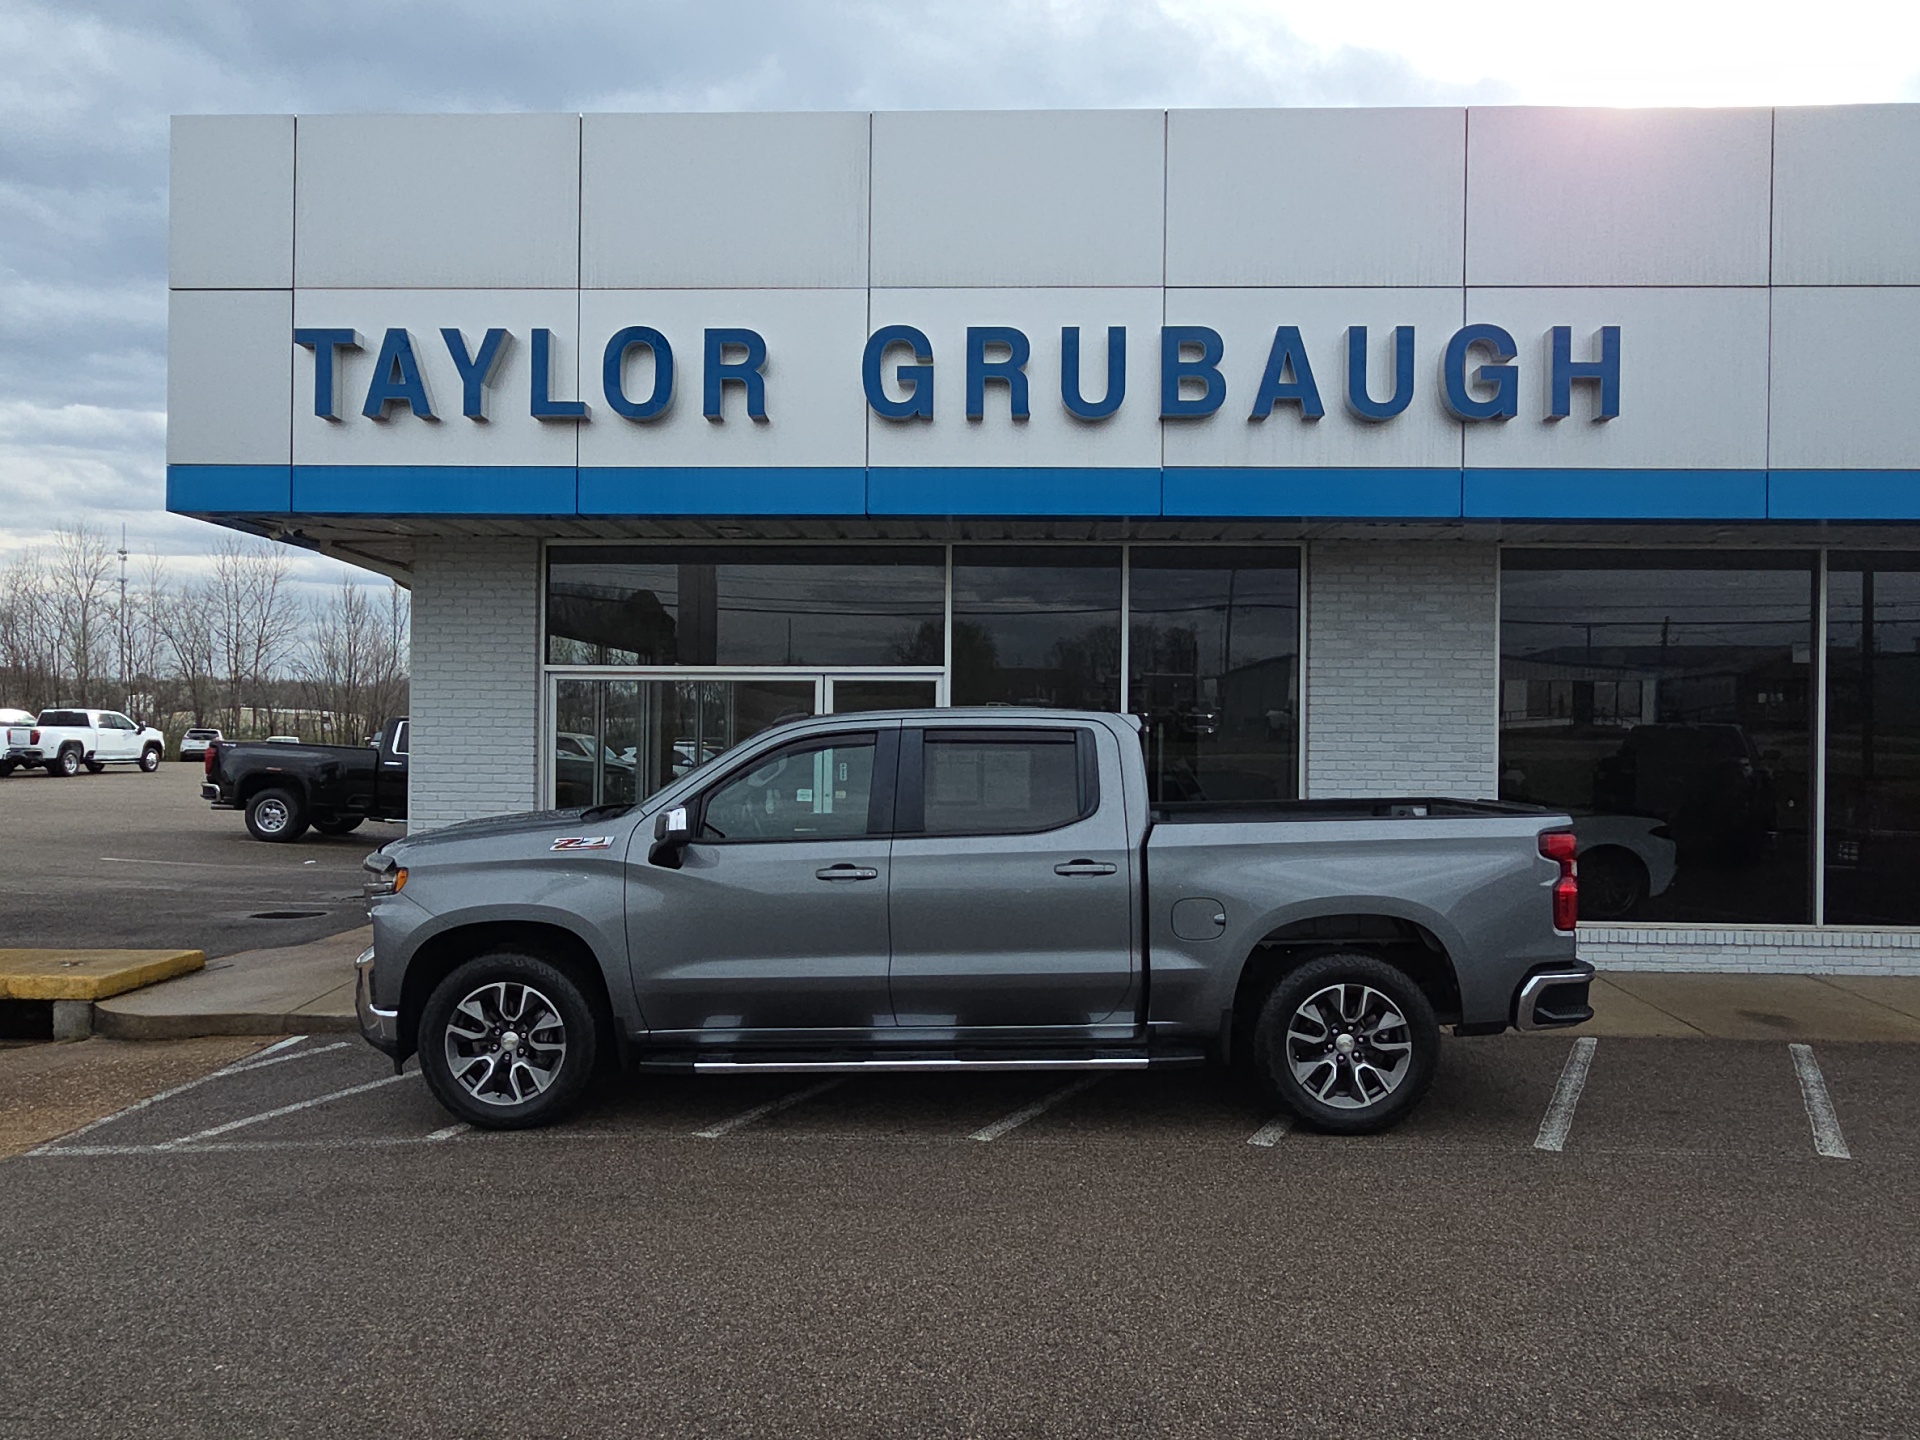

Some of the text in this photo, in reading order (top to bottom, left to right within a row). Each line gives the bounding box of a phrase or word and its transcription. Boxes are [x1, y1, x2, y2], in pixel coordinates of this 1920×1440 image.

[294, 324, 1622, 422] TAYLOR GRUBAUGH
[549, 836, 616, 851] Z71
